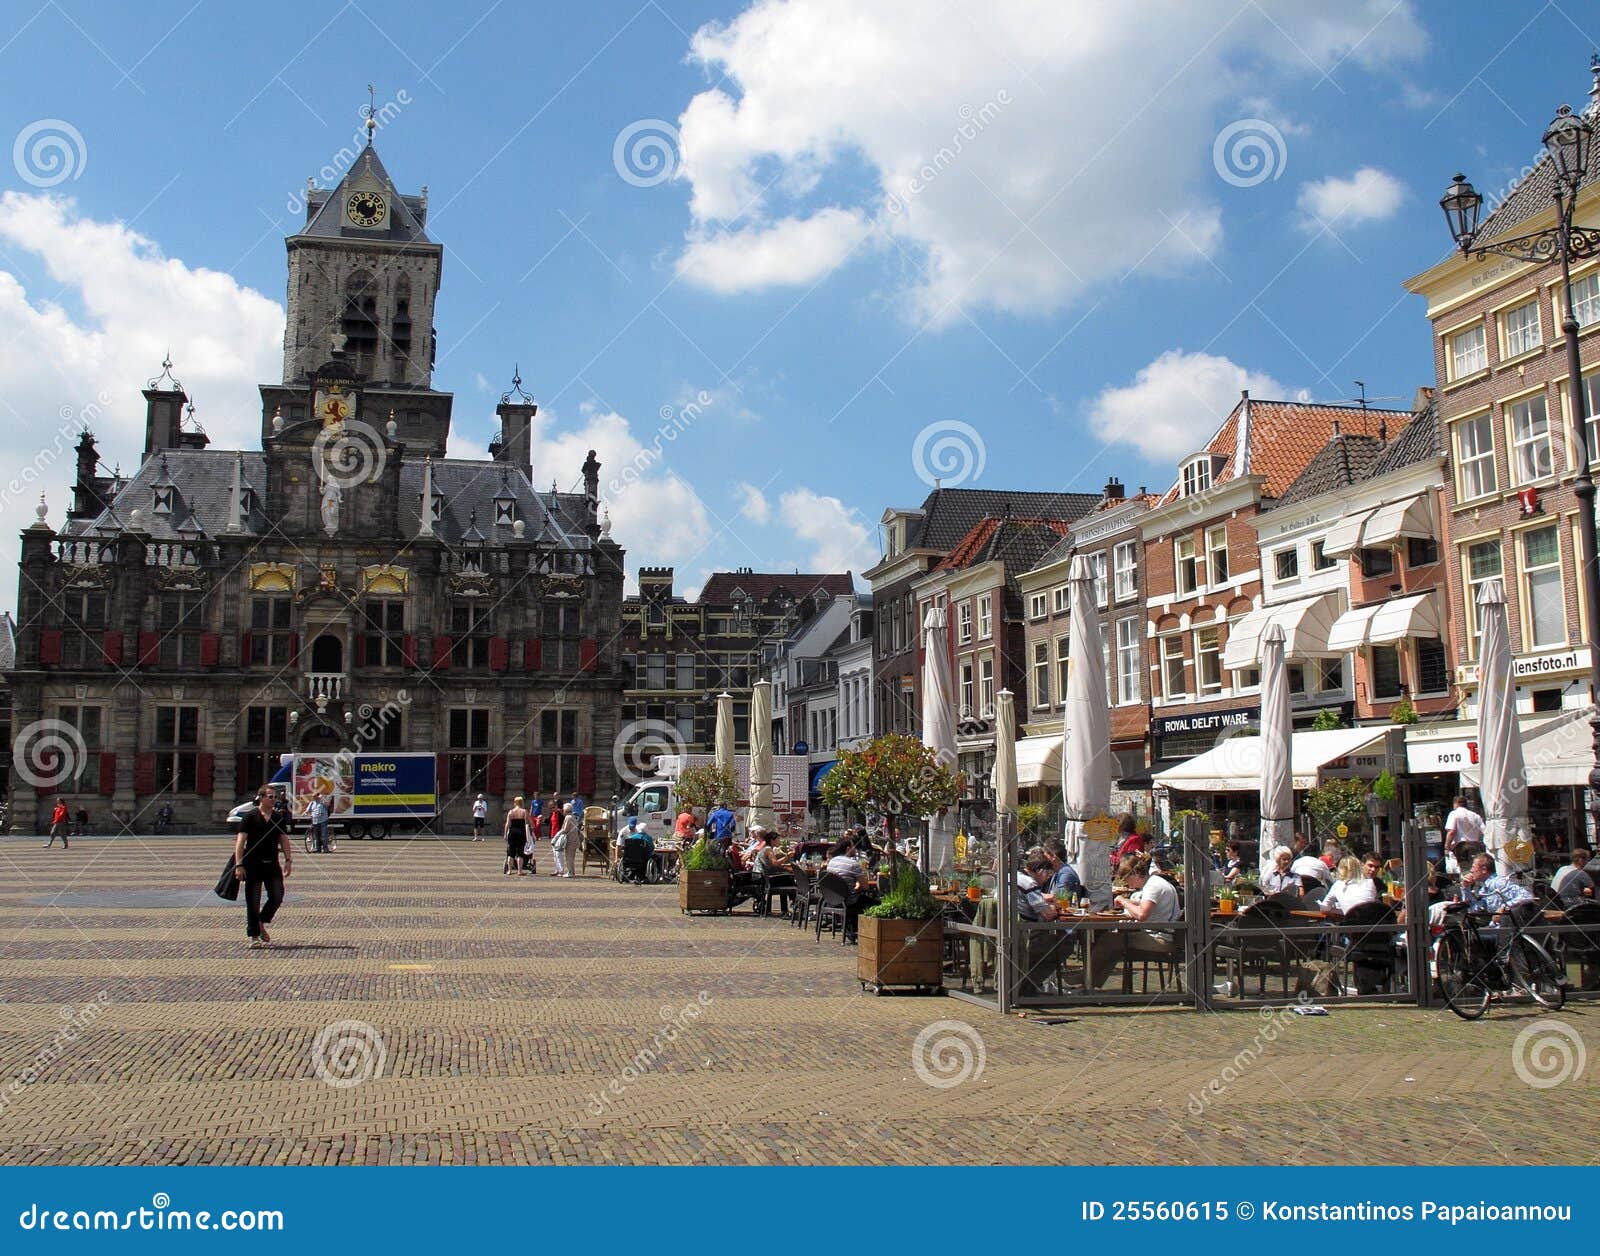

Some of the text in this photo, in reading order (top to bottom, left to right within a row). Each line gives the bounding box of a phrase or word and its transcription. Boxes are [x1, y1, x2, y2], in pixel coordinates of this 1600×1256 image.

[1164, 712, 1249, 732] ROYAL DELFT WARE
[1438, 753, 1462, 763] FOTO
[361, 762, 397, 772] makro
